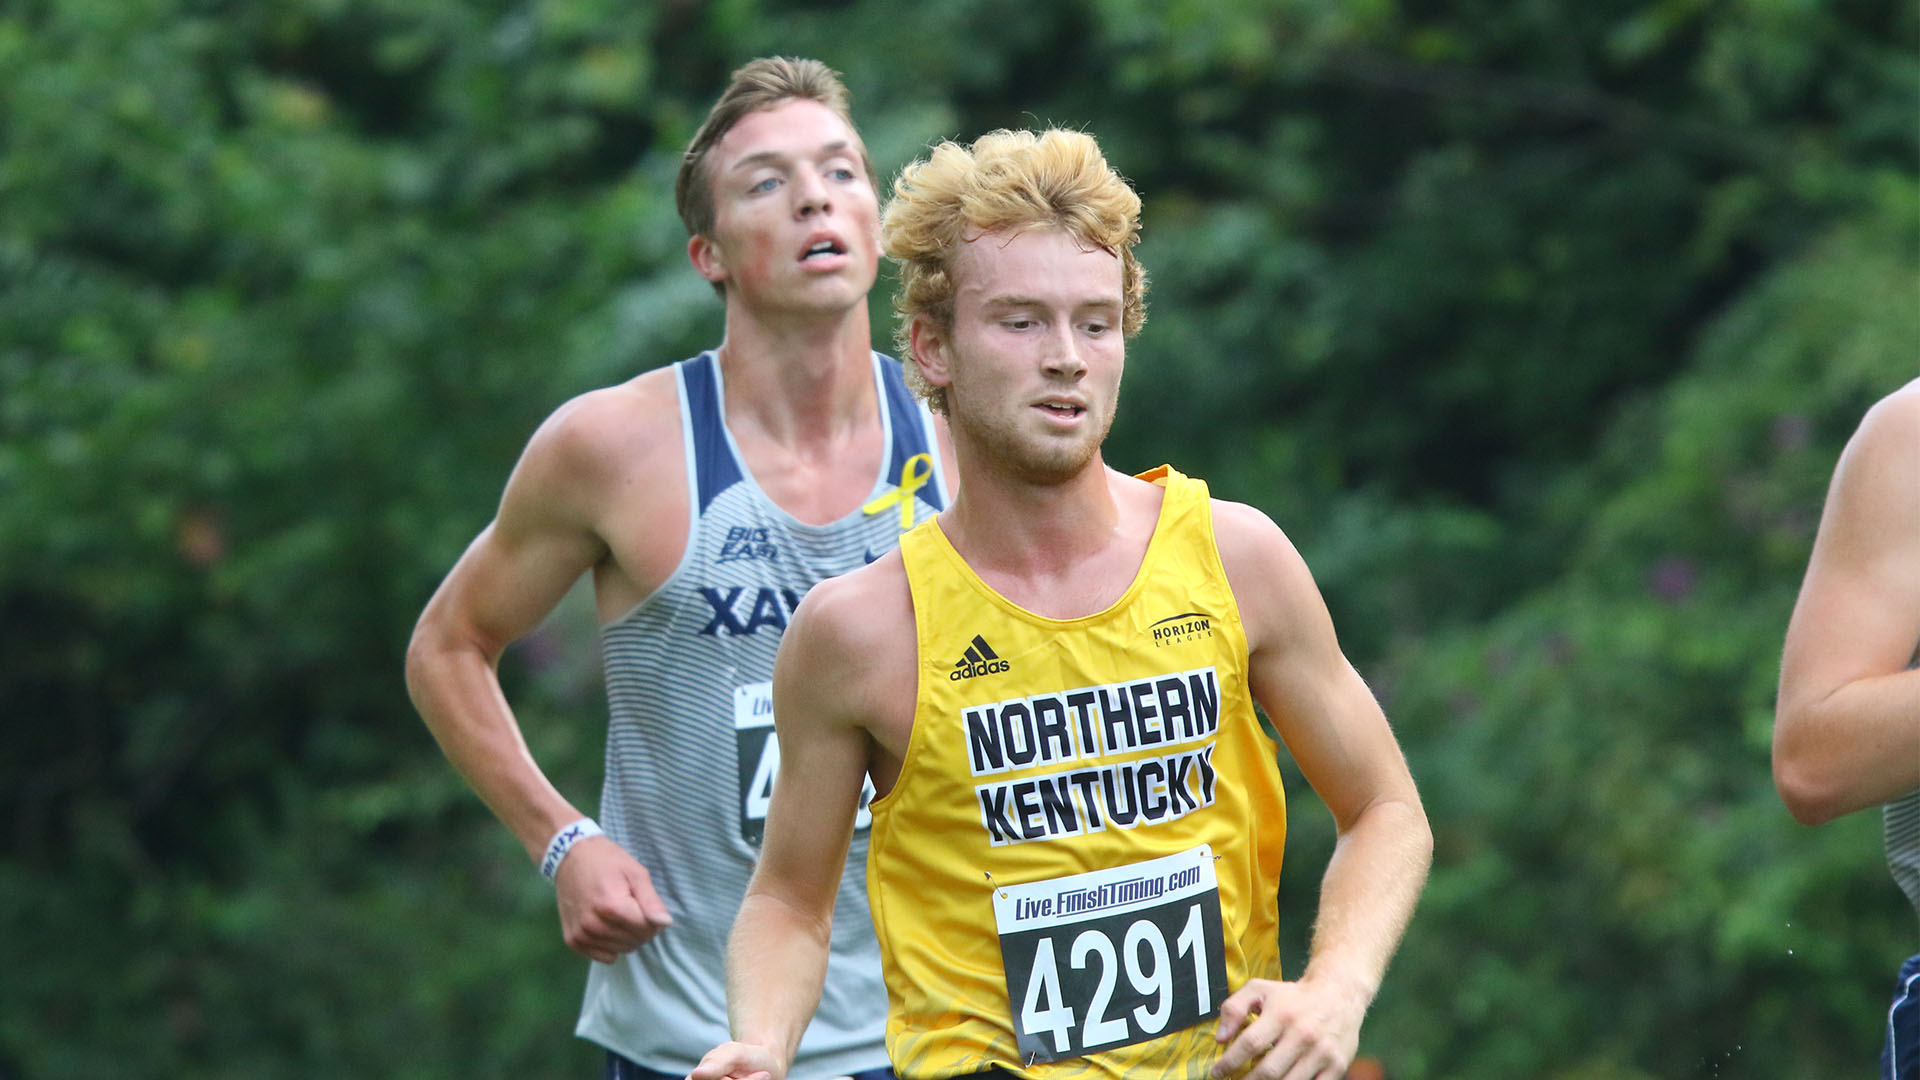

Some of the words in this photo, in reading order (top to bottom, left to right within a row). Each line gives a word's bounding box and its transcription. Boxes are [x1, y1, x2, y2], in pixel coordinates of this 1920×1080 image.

[727, 525, 769, 542] BIG
[1153, 619, 1210, 640] HORIZON
[1155, 631, 1214, 648] LEAGUE
[949, 658, 1010, 682] adidas
[965, 670, 1218, 773] NORTHERN
[979, 746, 1216, 842] KENTUCKY
[1015, 865, 1201, 921] Live.FinishTiming.com
[1021, 903, 1212, 1054] 4291
